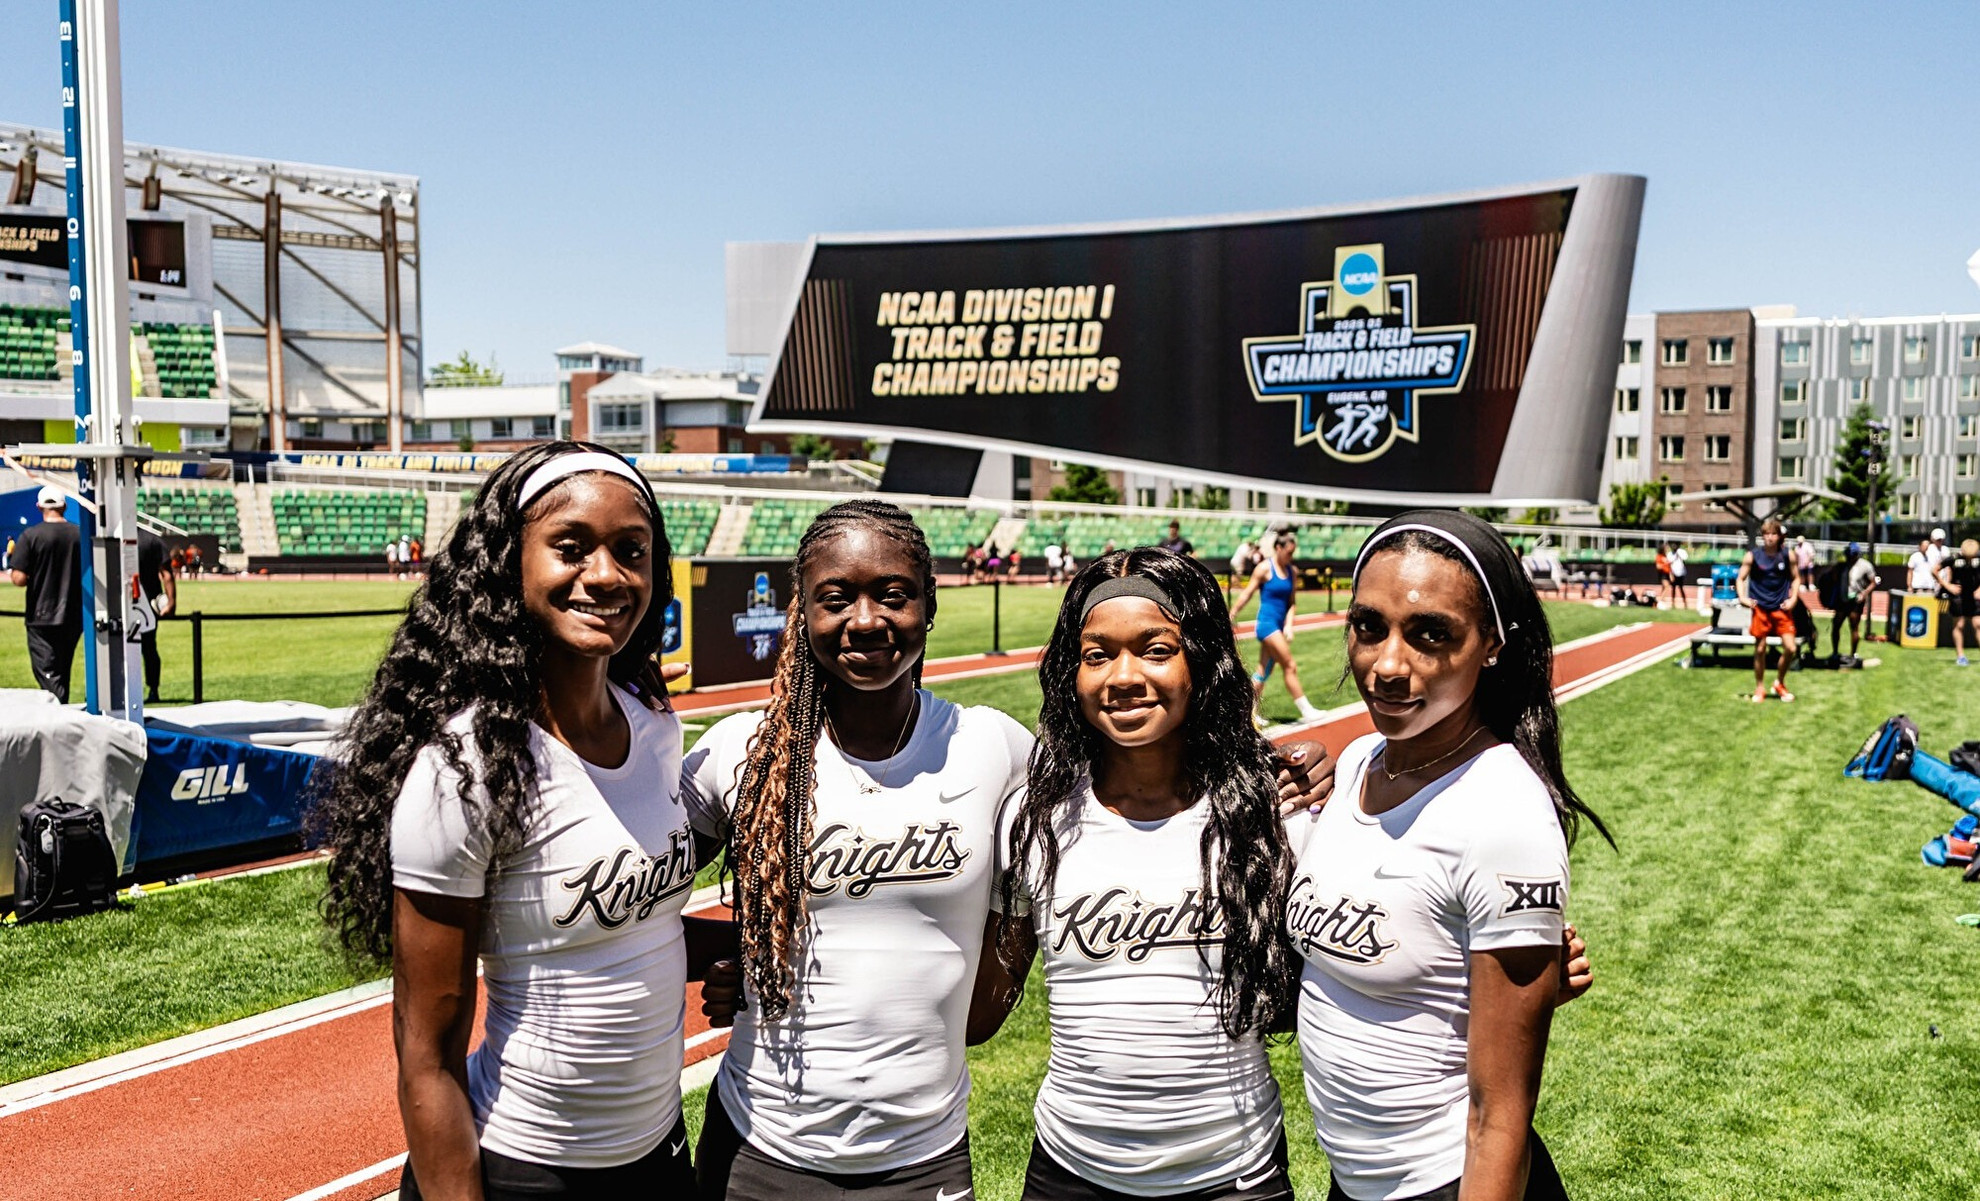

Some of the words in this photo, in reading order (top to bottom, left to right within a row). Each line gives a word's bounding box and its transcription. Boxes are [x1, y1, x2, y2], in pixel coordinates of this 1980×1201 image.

[60, 21, 71, 40] 13
[62, 87, 74, 107] 12
[67, 217, 78, 238] 10
[1343, 271, 1378, 286] NCAA
[69, 285, 81, 300] 9
[877, 290, 956, 326] NCAA
[961, 285, 1097, 324] DIVISION
[1100, 284, 1116, 320] I
[890, 325, 987, 360] TRACK
[990, 324, 1015, 358] &
[1019, 321, 1103, 357] FIELD
[1304, 331, 1353, 352] TRACK
[1354, 330, 1368, 348] &
[1369, 327, 1413, 347] FIELD
[72, 350, 83, 366] 8
[1264, 345, 1455, 383] CHAMPIONSHIPS
[872, 356, 1121, 396] CHAMPIONSHIPS
[361, 456, 402, 469] TRACK
[405, 456, 433, 470] AND
[170, 762, 250, 801] GILL
[1505, 880, 1561, 913] XII
